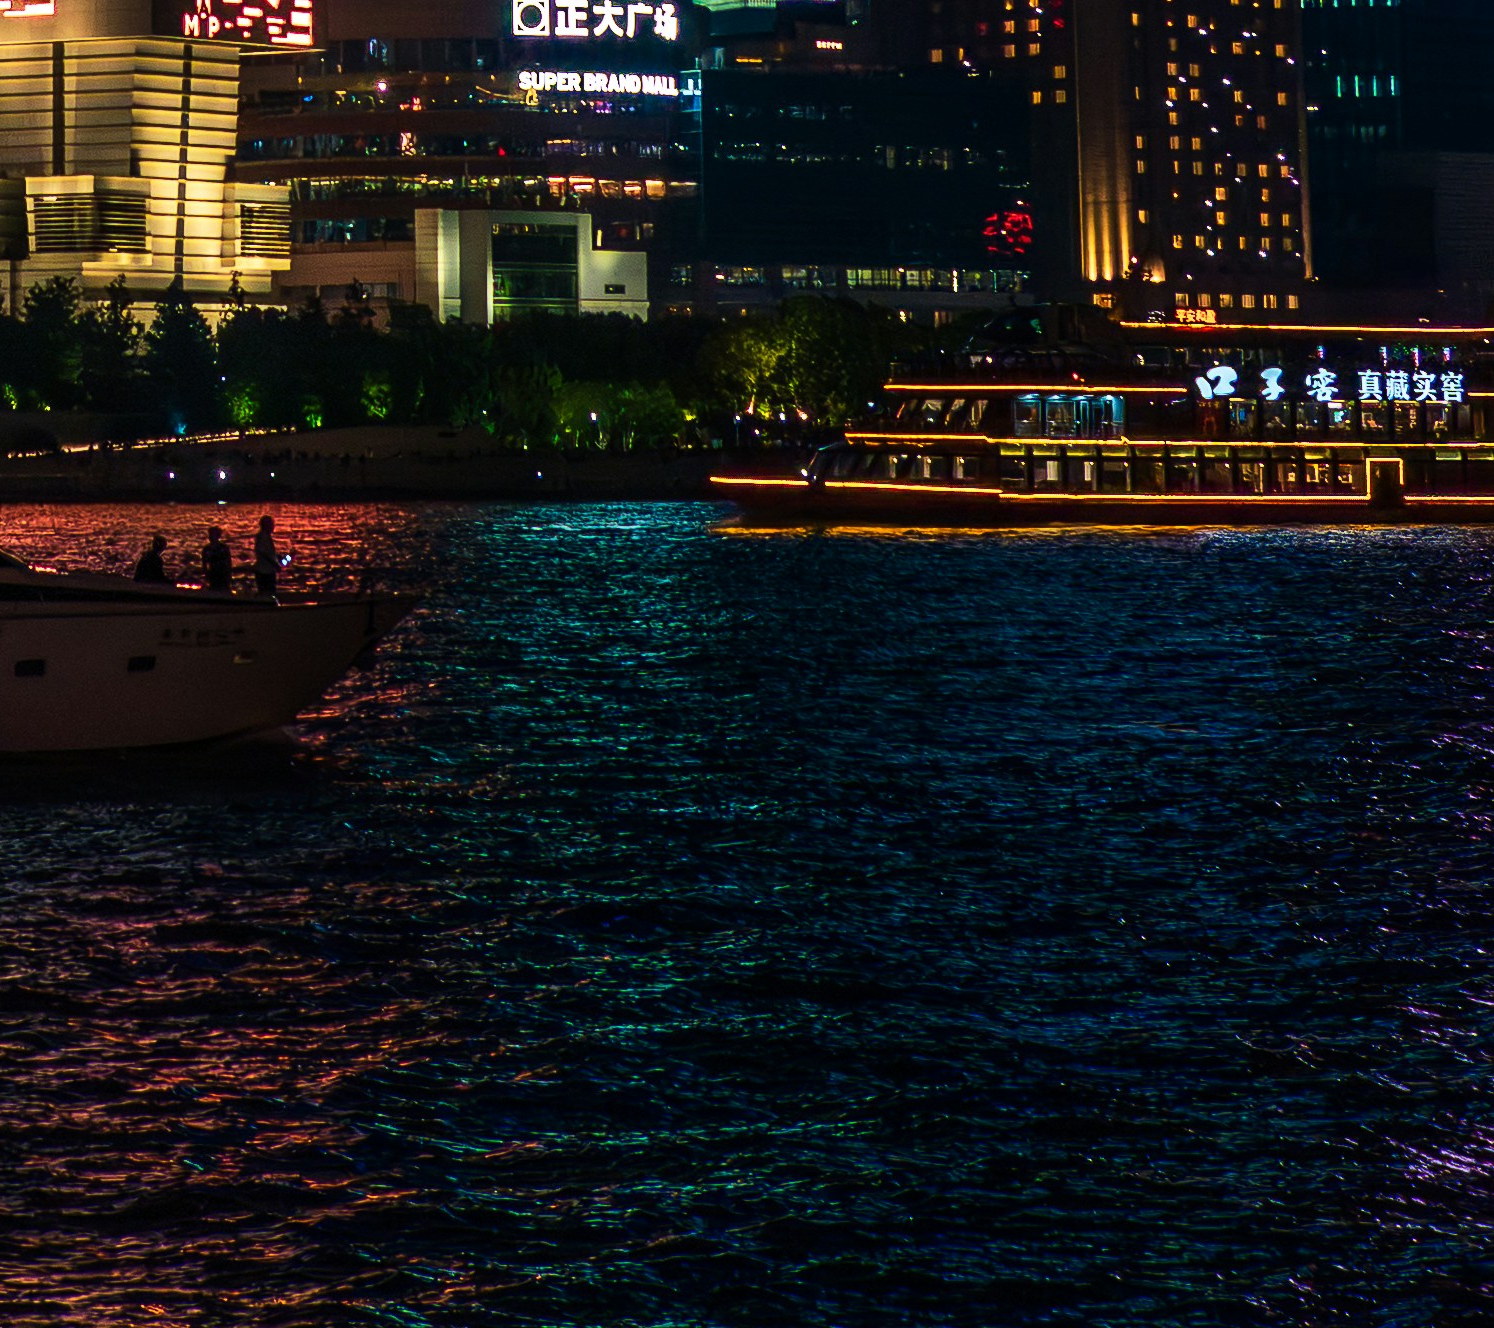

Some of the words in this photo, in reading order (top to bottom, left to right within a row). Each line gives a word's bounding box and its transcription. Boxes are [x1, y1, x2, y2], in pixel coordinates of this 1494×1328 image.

[518, 71, 582, 92] SUPER
[583, 72, 642, 94] BRAND
[641, 74, 679, 96] MALL
[1357, 368, 1465, 403] 真藏实窖
